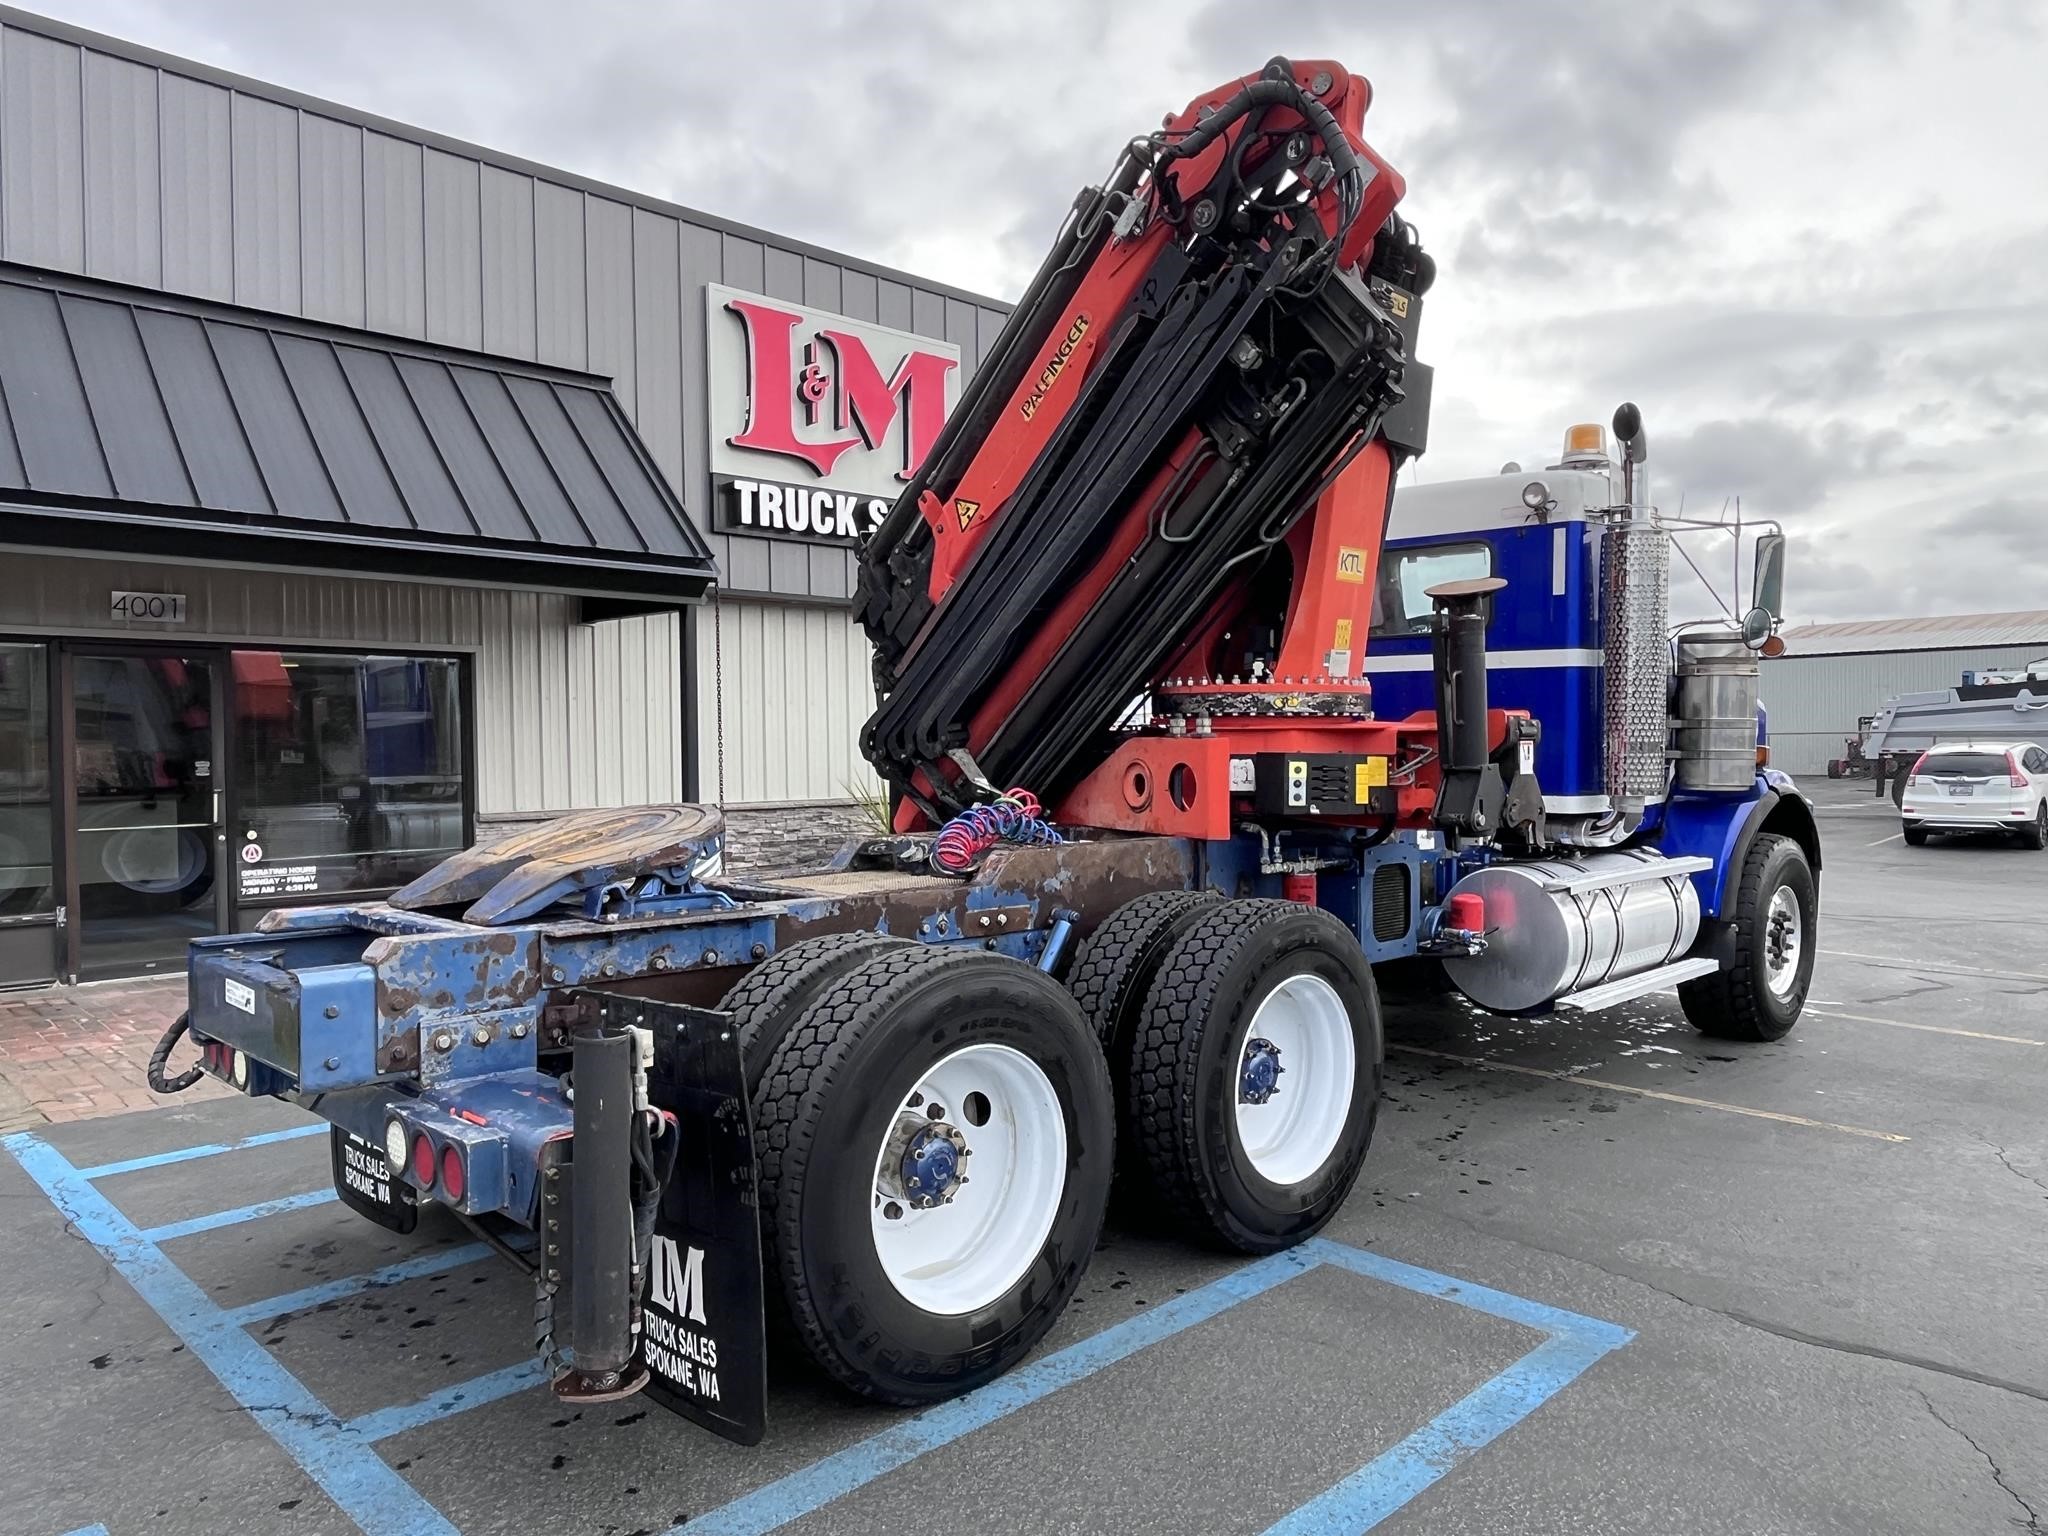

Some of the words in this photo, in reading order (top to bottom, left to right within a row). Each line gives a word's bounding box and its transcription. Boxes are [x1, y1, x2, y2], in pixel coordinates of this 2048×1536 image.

[1021, 314, 1089, 419] PALFINGER
[733, 480, 860, 538] TRUCK
[112, 595, 177, 619] 4001
[241, 867, 287, 877] OPERATING
[288, 866, 317, 875] HOURS
[242, 877, 280, 887] MONDAY
[286, 875, 316, 884] FRIDAY
[260, 885, 276, 894] AM
[303, 883, 318, 891] PM
[345, 1144, 366, 1172] TRUCK
[366, 1155, 390, 1182] SALES
[346, 1165, 377, 1202] SPOKANE,
[377, 1182, 391, 1205] WA
[644, 1308, 677, 1351] TRUCK
[678, 1327, 717, 1368] SALES
[645, 1339, 697, 1396] SPOKANE,
[698, 1367, 721, 1402] WA
